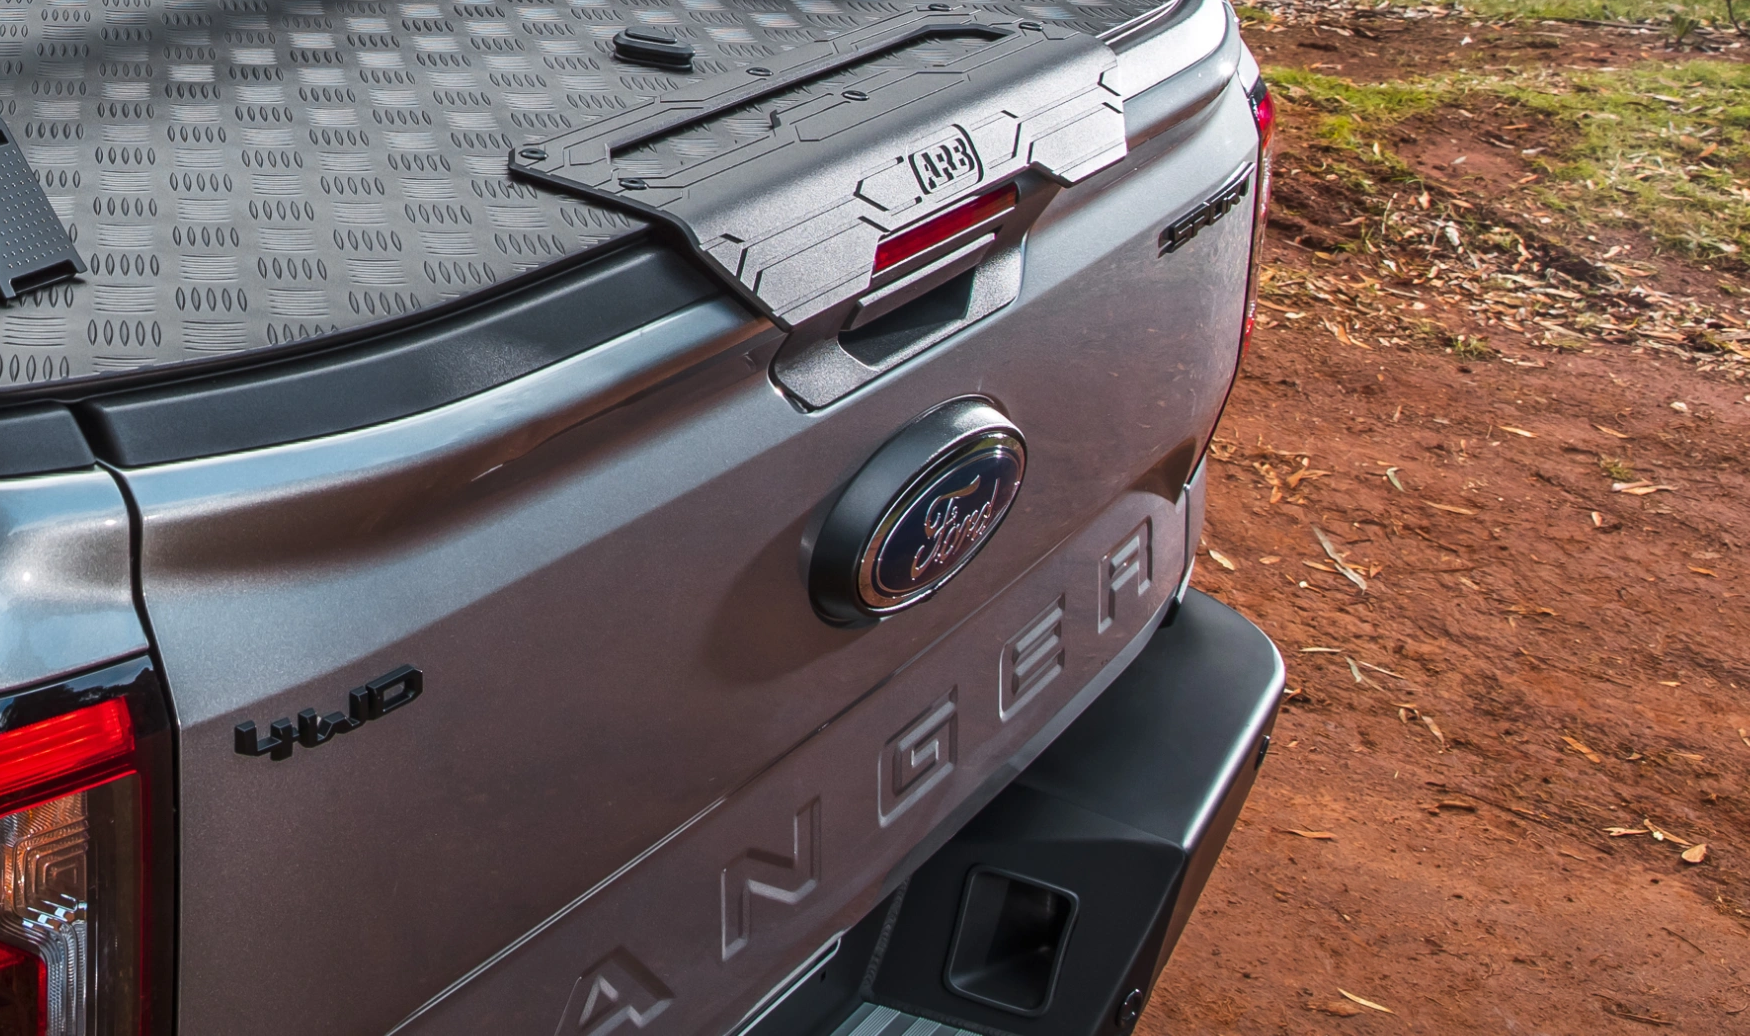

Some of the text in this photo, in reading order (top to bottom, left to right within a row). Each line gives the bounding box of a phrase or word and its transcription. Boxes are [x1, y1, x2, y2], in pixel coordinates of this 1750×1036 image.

[918, 136, 976, 191] ARB
[911, 474, 1000, 581] Ford
[234, 663, 423, 762] 4WD
